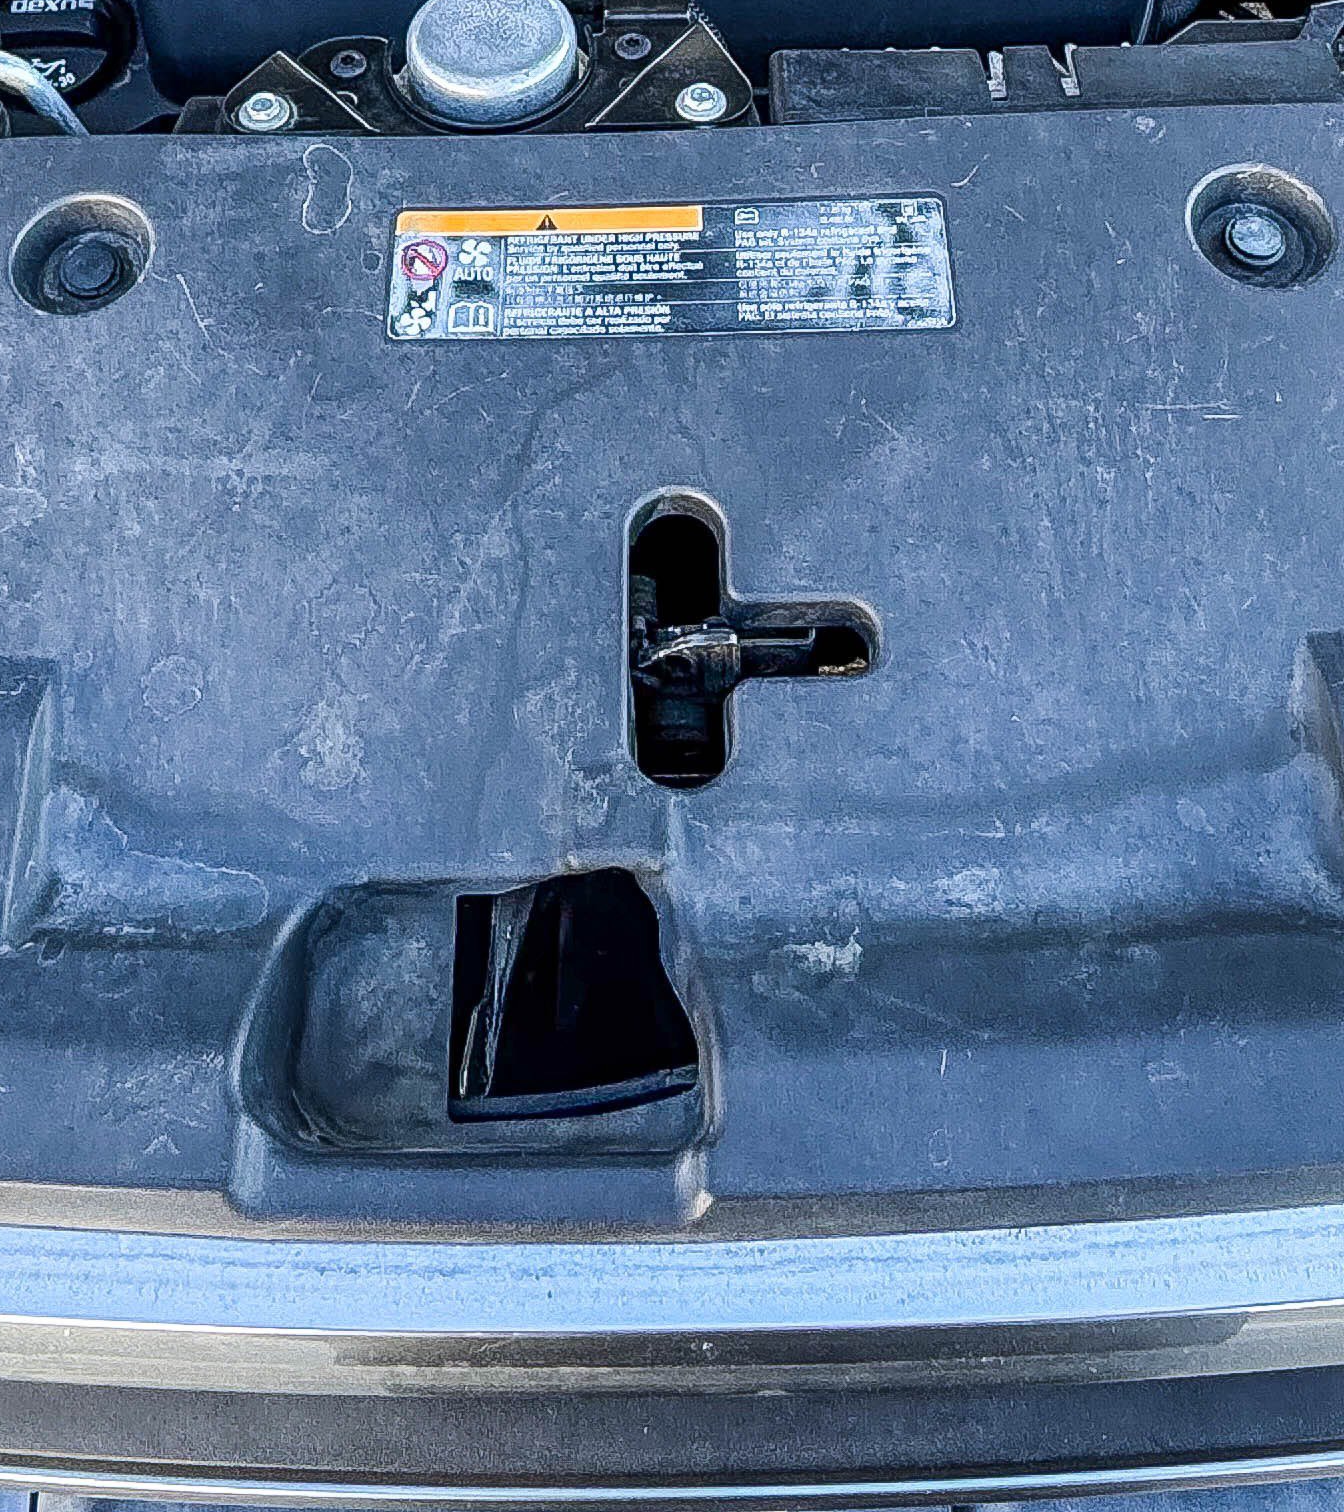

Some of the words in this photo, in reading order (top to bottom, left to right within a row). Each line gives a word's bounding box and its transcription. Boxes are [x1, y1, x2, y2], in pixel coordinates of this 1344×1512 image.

[618, 232, 644, 242] HIGH
[645, 231, 700, 242] PRESSURE
[452, 266, 495, 281] AUTO
[584, 305, 595, 316] A
[595, 305, 622, 316] ALTA
